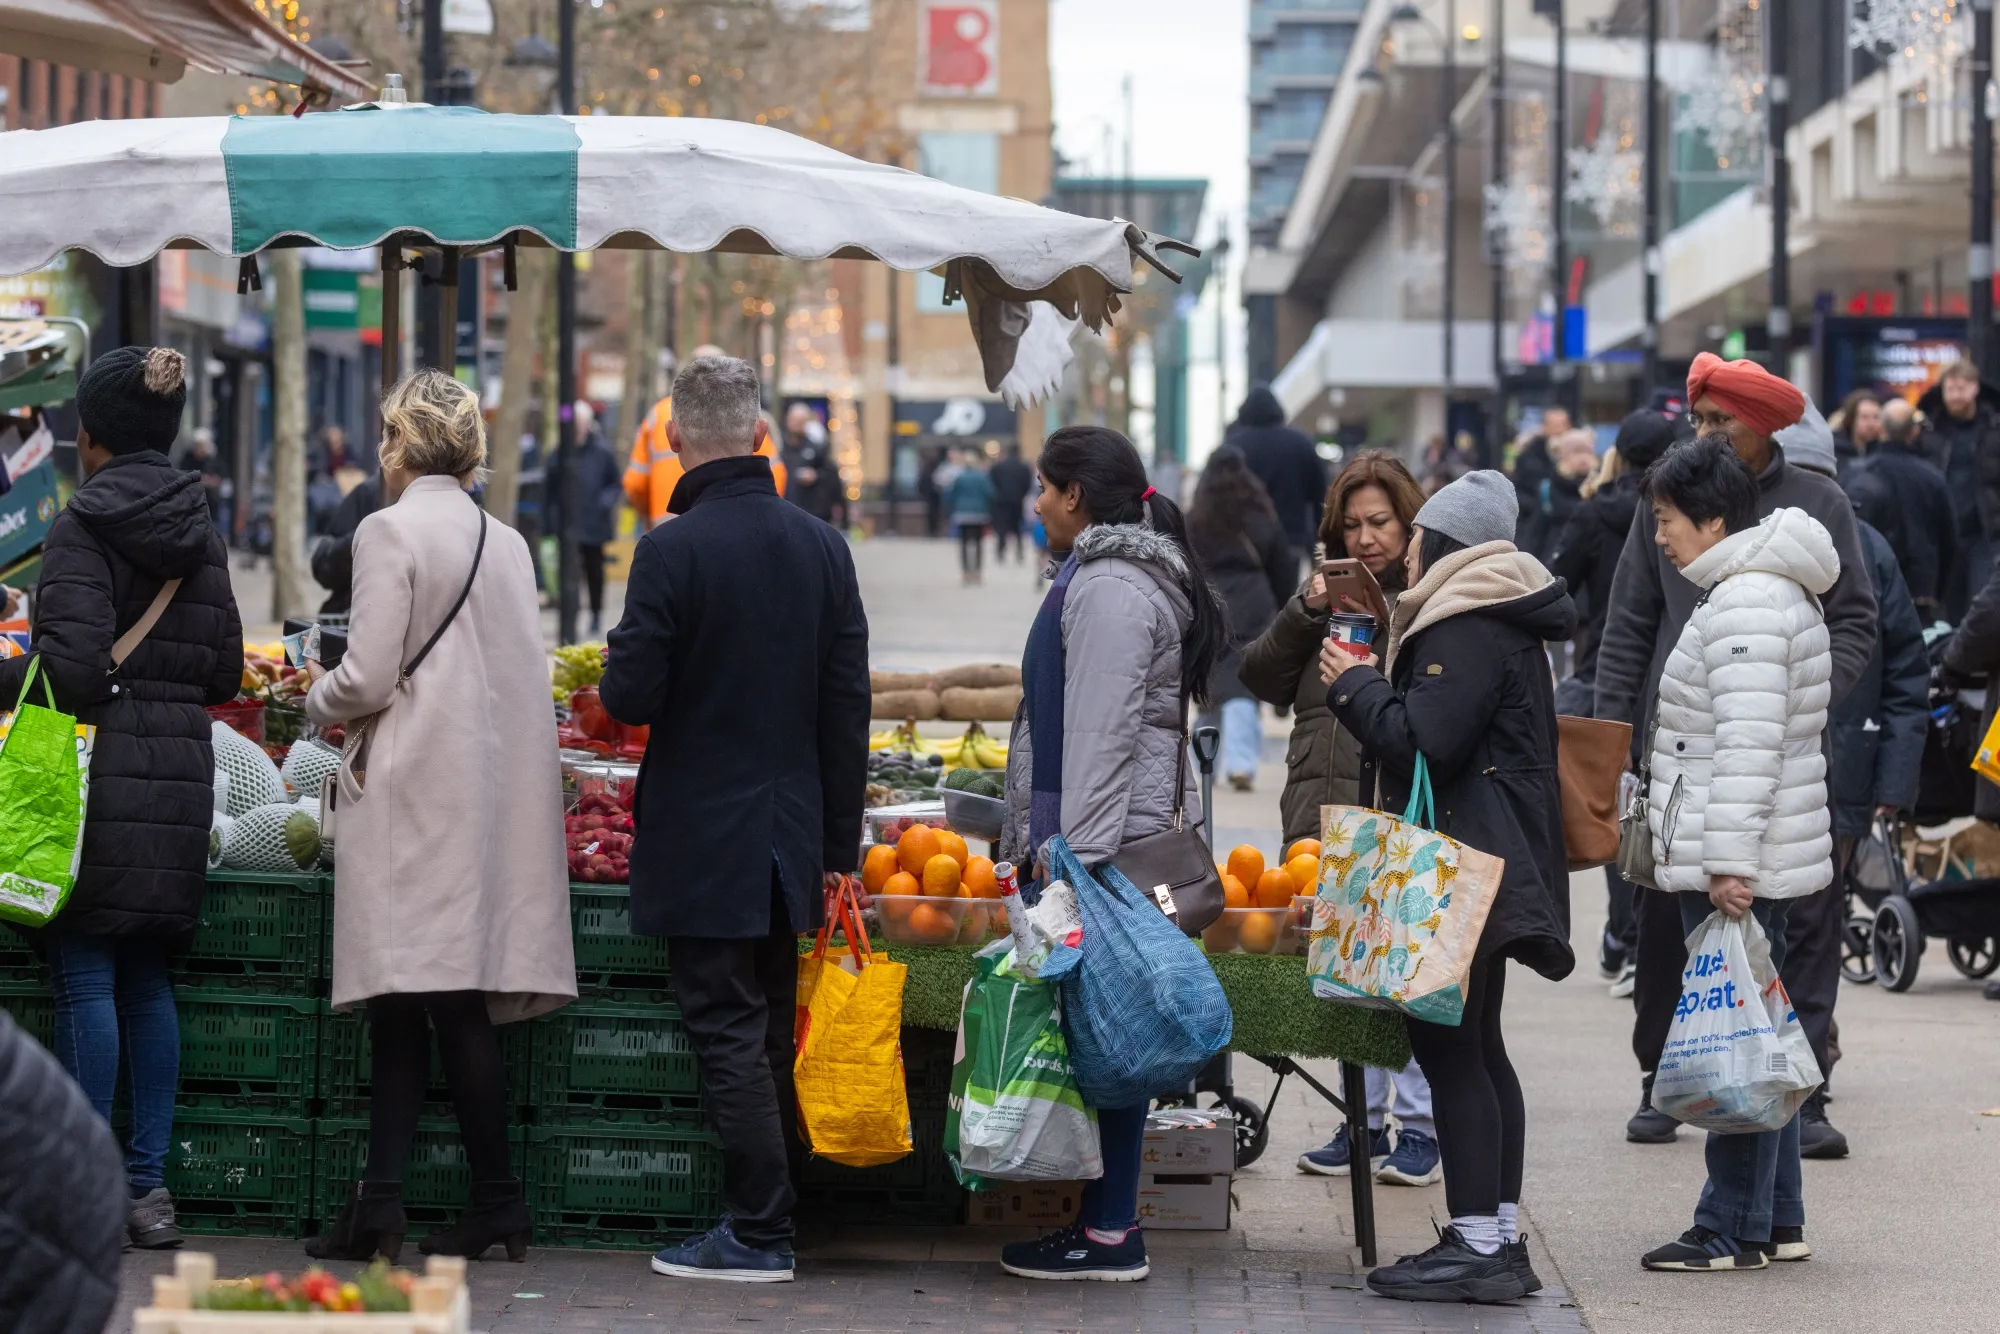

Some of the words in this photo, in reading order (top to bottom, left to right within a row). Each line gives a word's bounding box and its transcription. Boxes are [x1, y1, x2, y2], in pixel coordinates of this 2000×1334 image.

[1731, 646, 1748, 655] DKNY
[0, 876, 45, 901] ASDA
[1700, 1047, 1712, 1056] you
